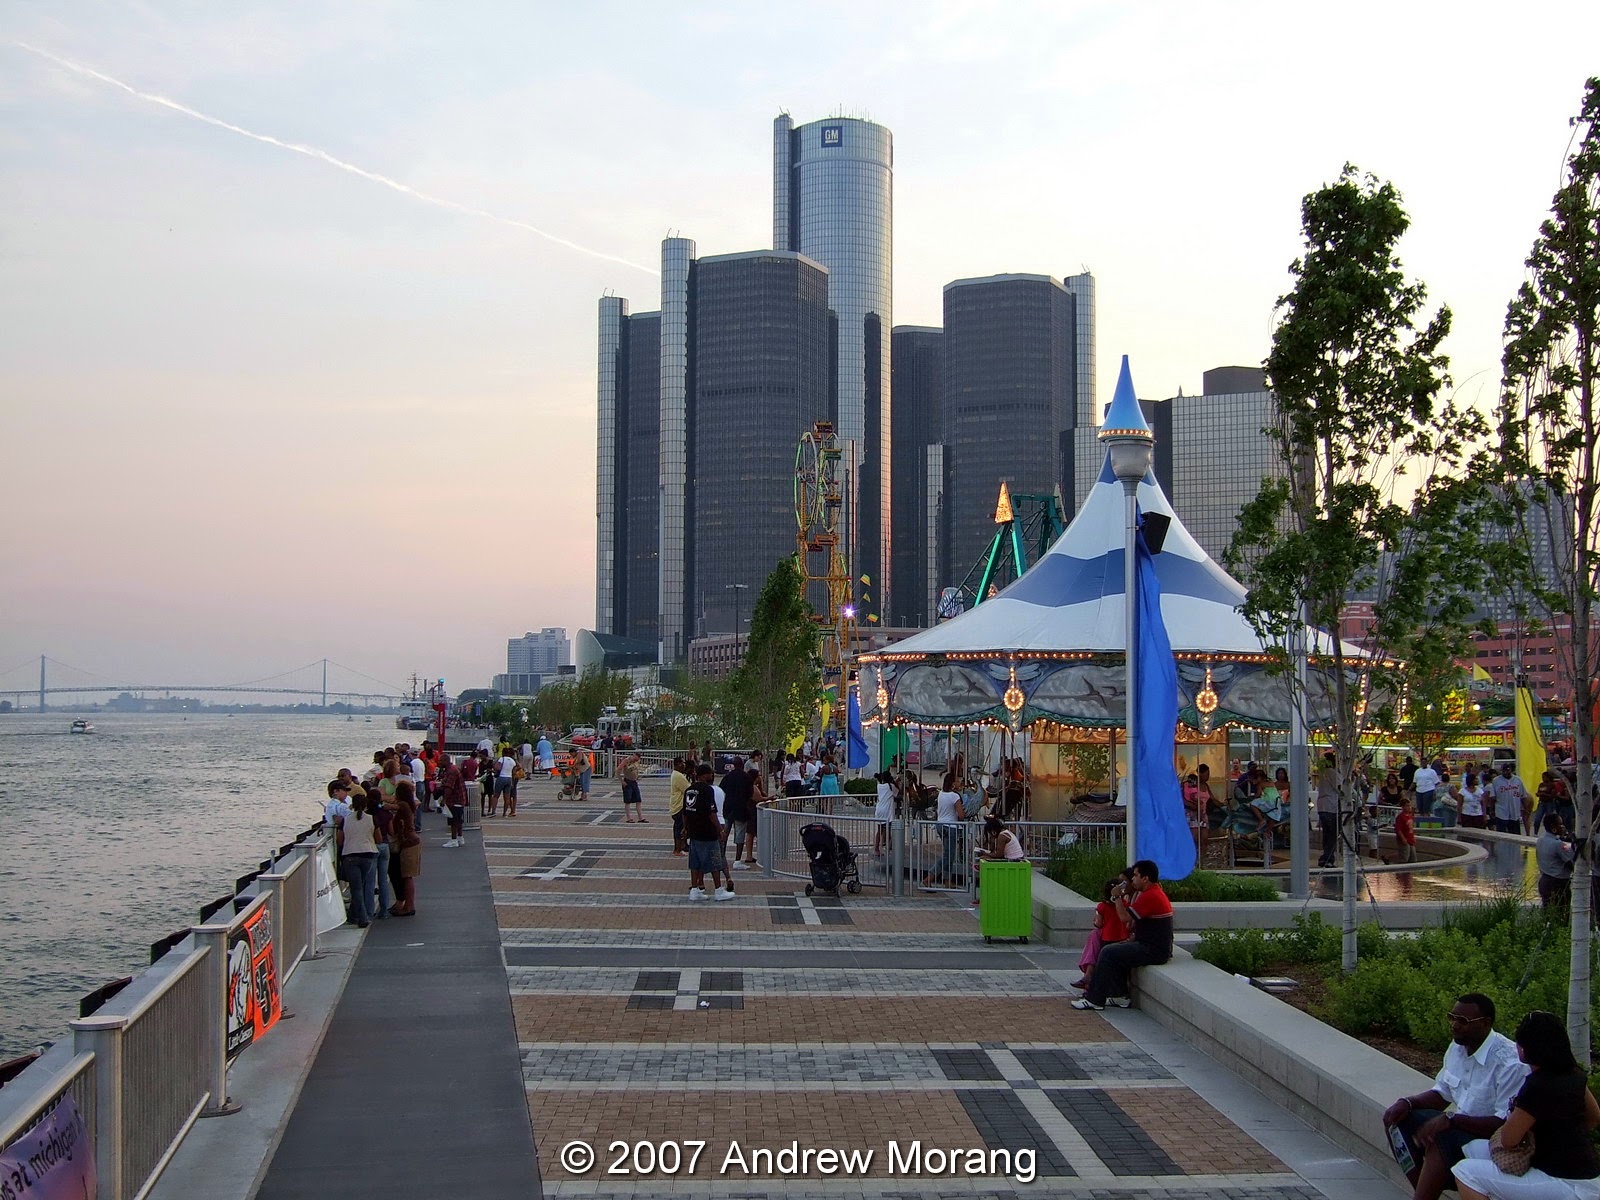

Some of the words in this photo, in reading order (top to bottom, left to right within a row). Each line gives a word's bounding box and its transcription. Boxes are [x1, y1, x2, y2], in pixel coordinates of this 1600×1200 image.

[825, 130, 838, 140] GM
[1448, 734, 1503, 744] MBURGERS
[11, 1162, 32, 1192] at
